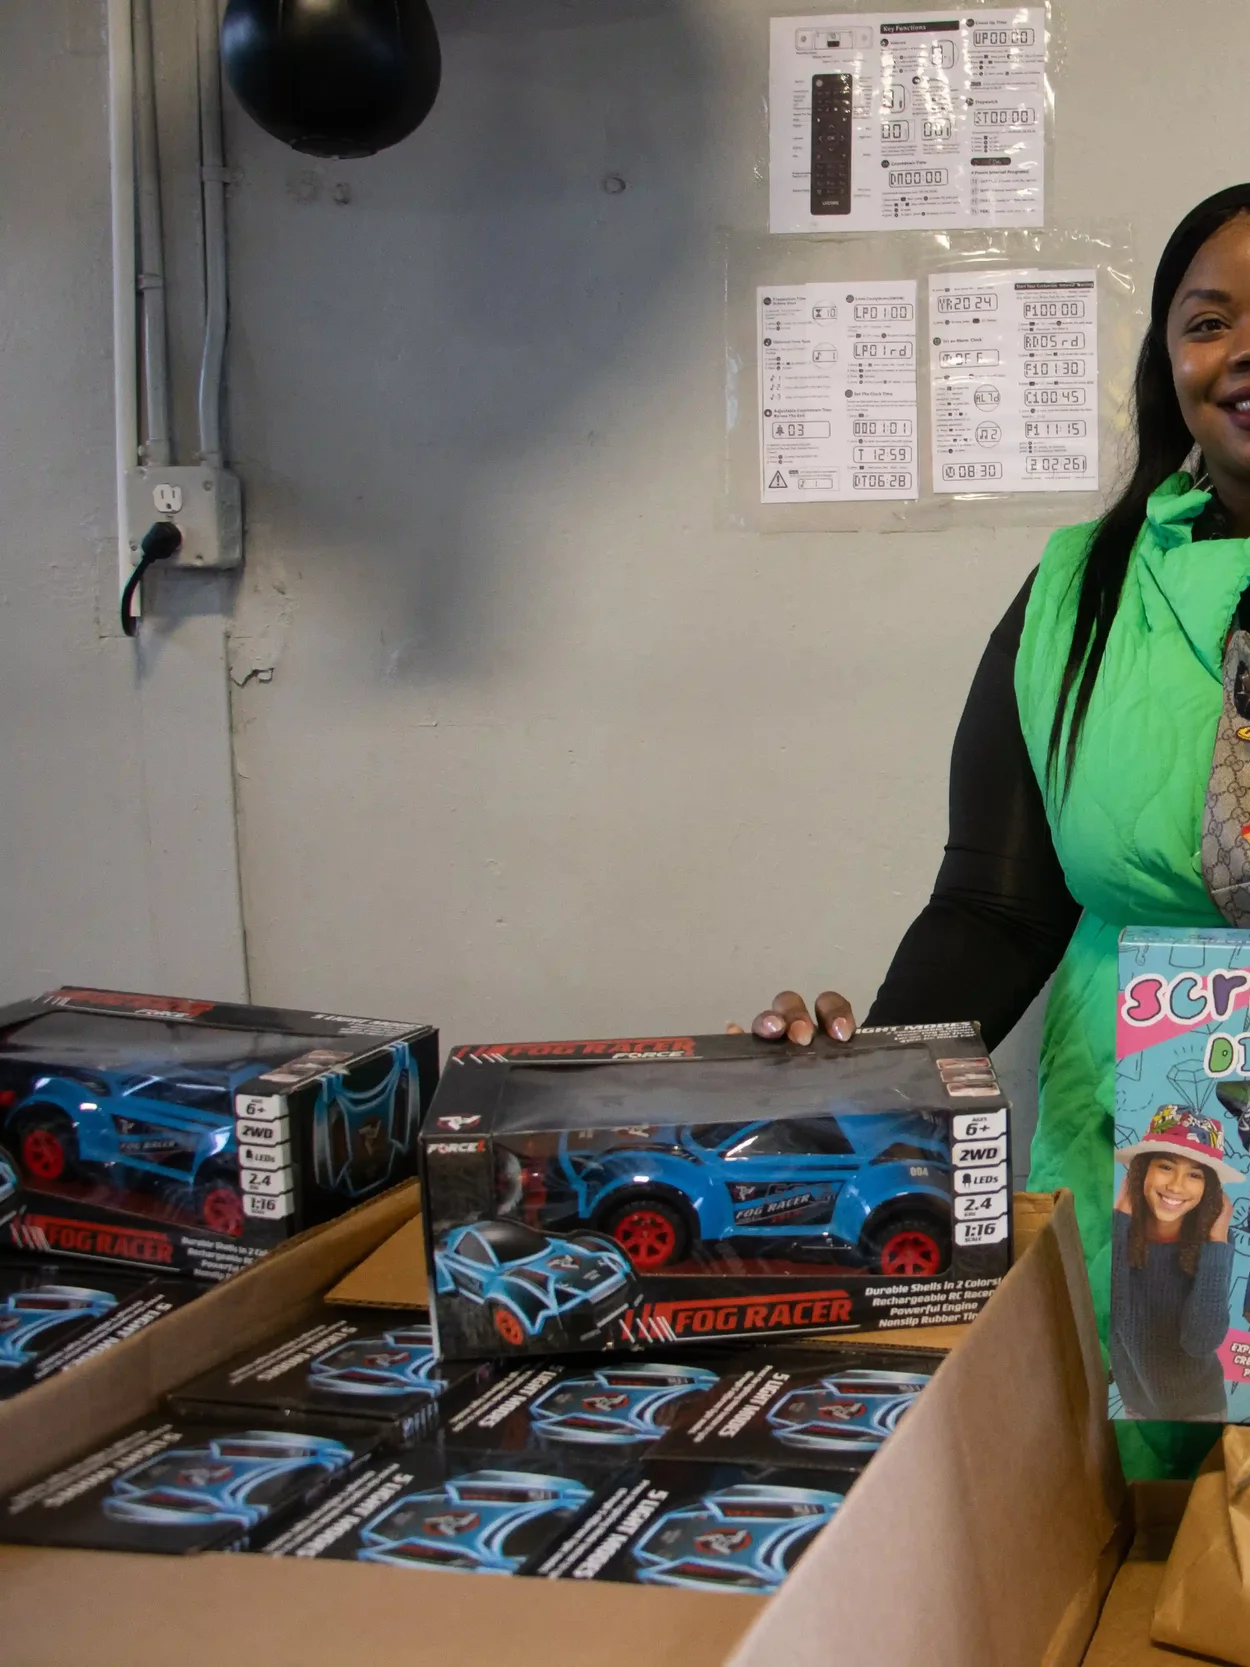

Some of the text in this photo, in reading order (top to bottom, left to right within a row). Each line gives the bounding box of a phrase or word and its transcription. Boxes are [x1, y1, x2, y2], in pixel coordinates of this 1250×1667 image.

[882, 24, 926, 33] Key Functions
[788, 424, 804, 436] 03
[874, 450, 906, 460] 12:59
[854, 476, 906, 487] DT06:28
[246, 1103, 266, 1115] 6+
[242, 1125, 274, 1139] 2WD
[966, 1122, 990, 1136] 6+
[959, 1147, 998, 1162] 2WD
[249, 1174, 272, 1186] 2.4
[973, 1176, 999, 1185] LEDs
[250, 1197, 276, 1210] 1:16
[736, 1194, 812, 1219] FOG RACER
[964, 1198, 992, 1212] 2.4
[964, 1223, 996, 1237] 1:16
[50, 1222, 174, 1264] FOG RACER
[865, 1277, 1002, 1296] Durable Shells in 2 Colors!
[872, 1294, 947, 1307] Rechargeable
[948, 1291, 962, 1300] RC
[890, 1302, 978, 1316] Powerful Engine
[674, 1300, 852, 1334] FOG RACER
[879, 1312, 980, 1328] Nonslip Rubber Tir
